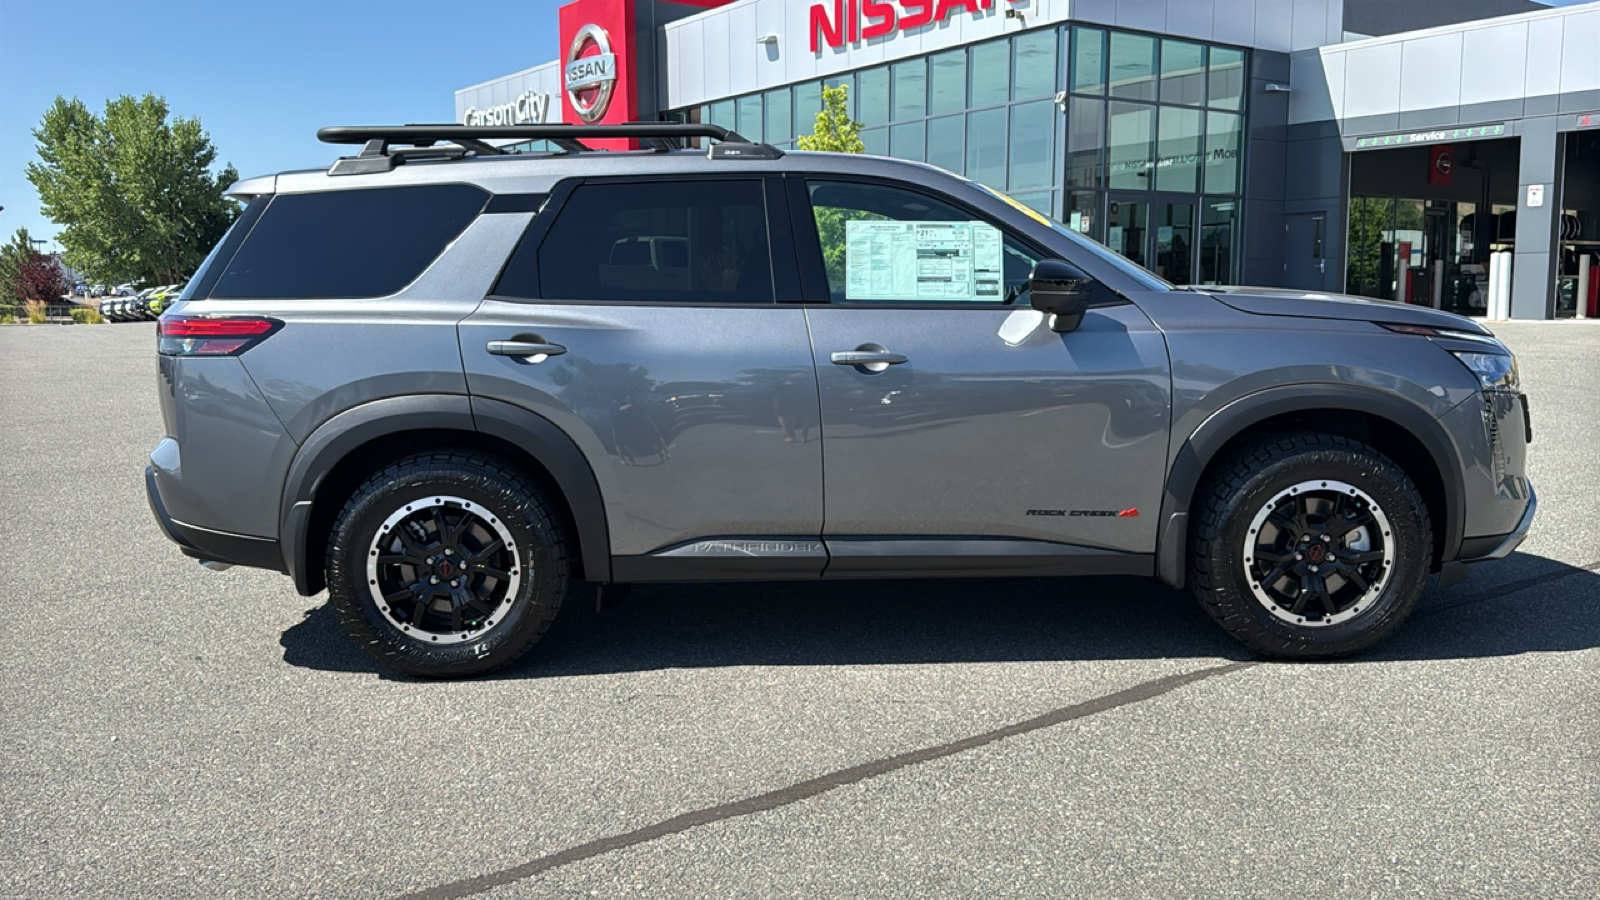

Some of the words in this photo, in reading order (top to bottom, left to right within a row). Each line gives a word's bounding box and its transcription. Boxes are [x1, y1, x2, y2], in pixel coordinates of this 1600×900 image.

[809, 0, 1024, 52] NISS
[568, 59, 606, 81] ISSAN
[463, 105, 516, 126] Carson
[516, 88, 550, 124] City
[1408, 130, 1446, 142] Service
[1025, 509, 1067, 517] ROCK
[693, 543, 821, 552] PATHFINDER
